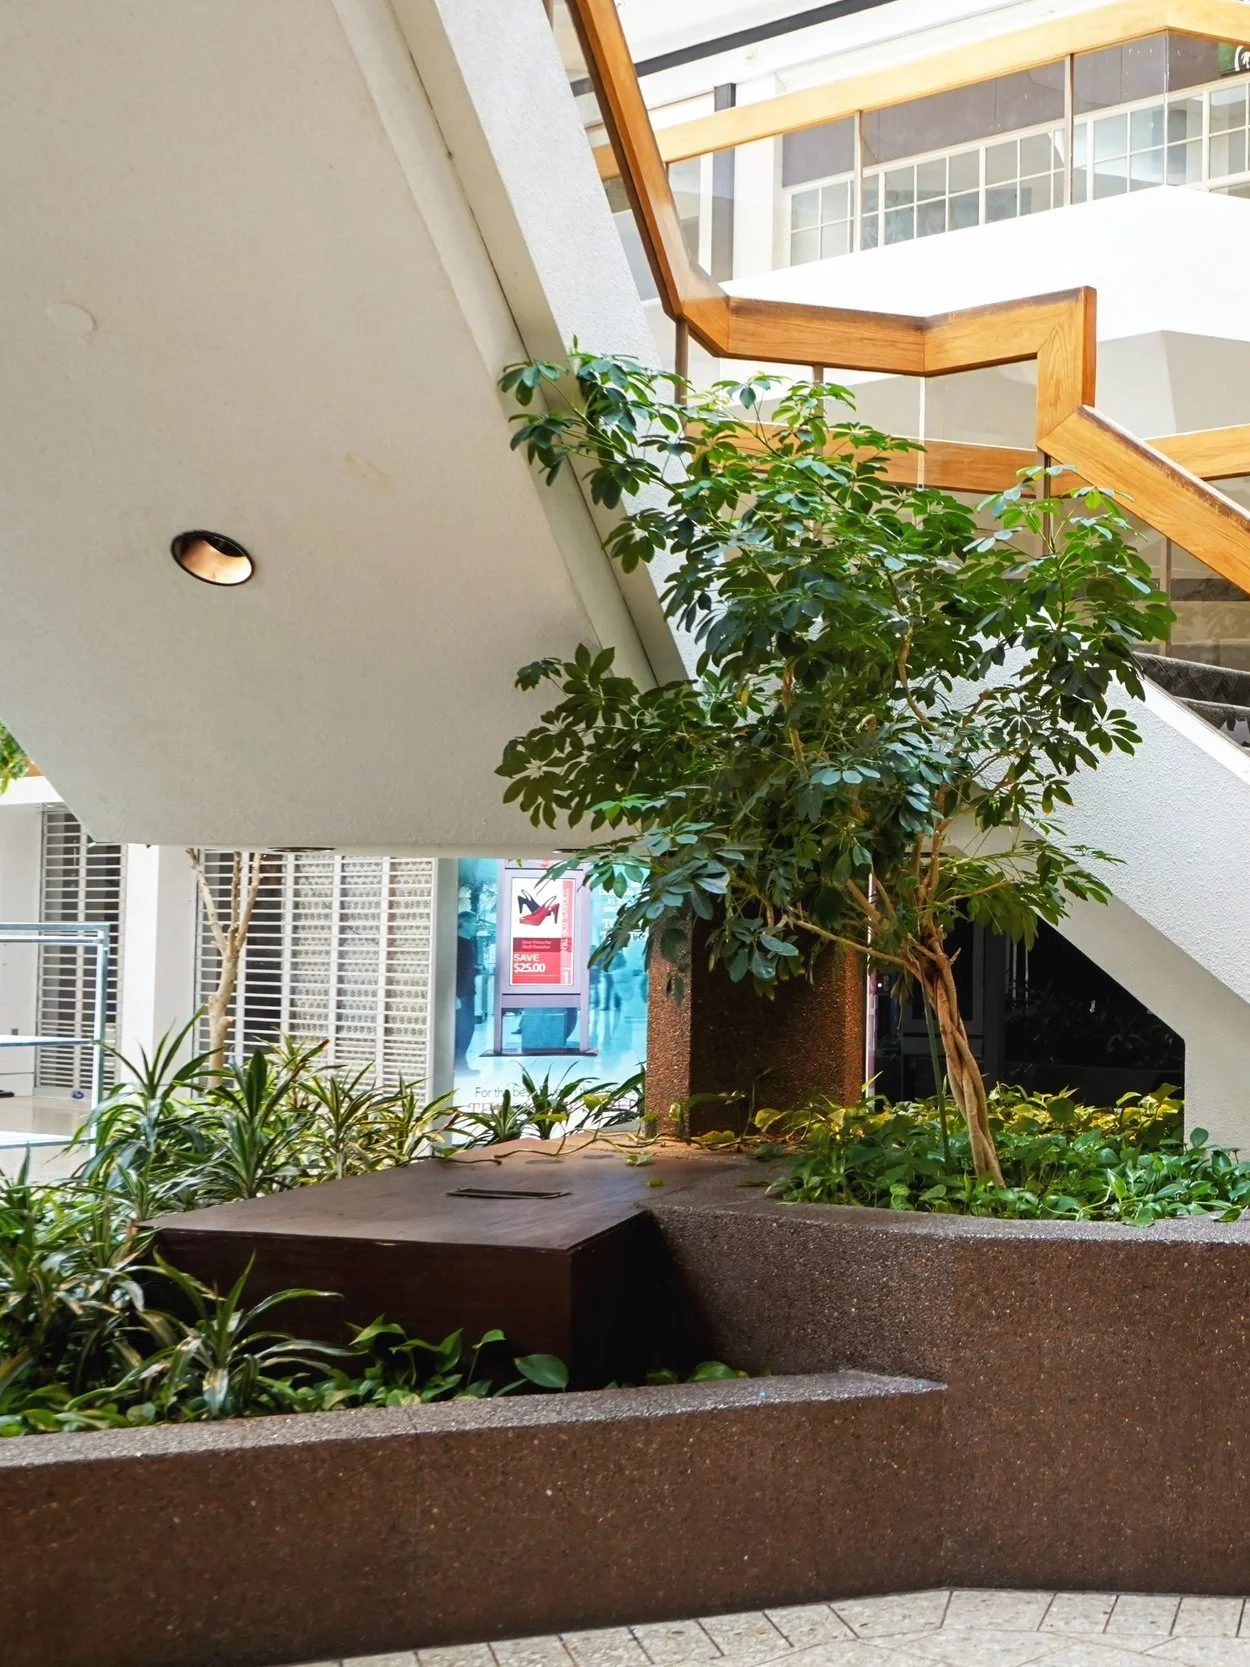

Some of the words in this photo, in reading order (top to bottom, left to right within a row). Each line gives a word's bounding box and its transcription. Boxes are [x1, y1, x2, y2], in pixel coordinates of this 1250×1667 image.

[513, 953, 540, 962] SAVE
[513, 962, 546, 973] $25.00
[475, 1086, 491, 1098] For
